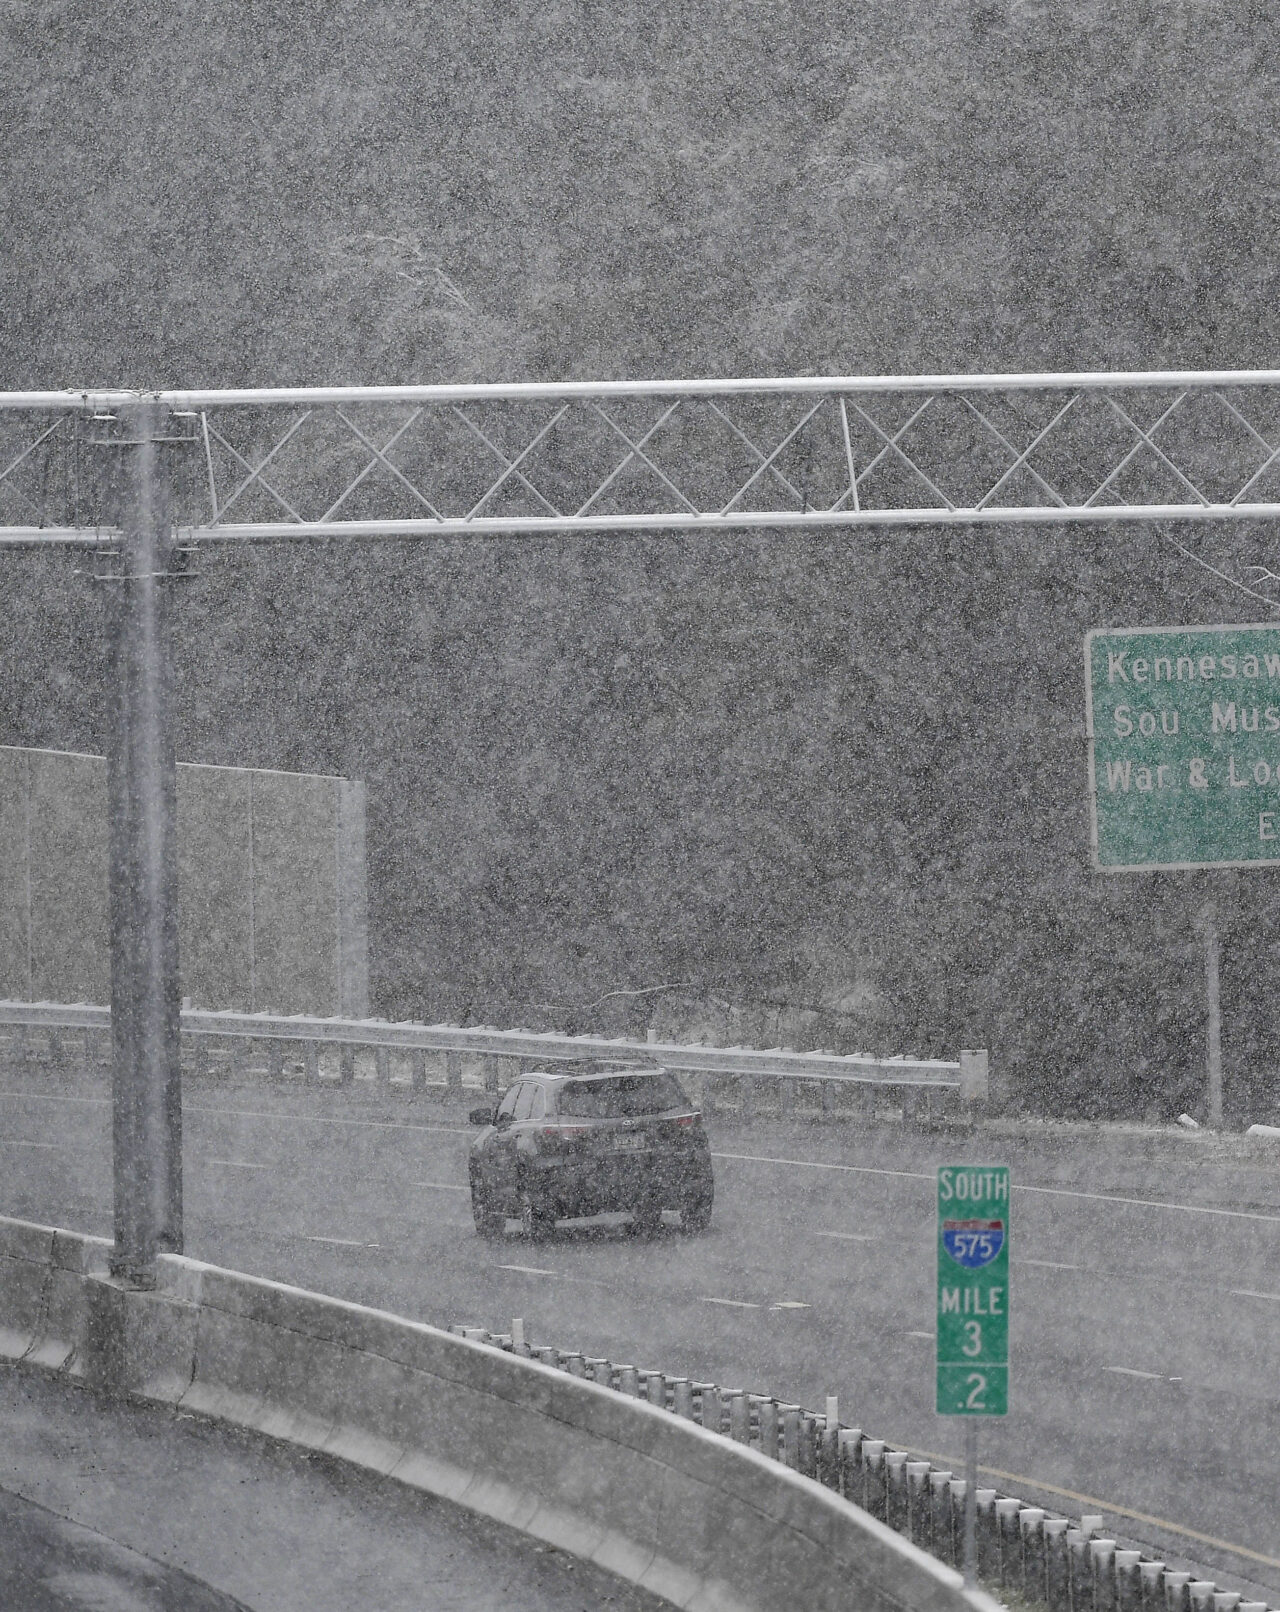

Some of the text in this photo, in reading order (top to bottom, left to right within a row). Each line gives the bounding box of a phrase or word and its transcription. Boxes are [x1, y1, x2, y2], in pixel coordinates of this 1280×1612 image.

[1113, 705, 1179, 738] Sou
[1106, 761, 1167, 793] War
[1188, 757, 1209, 789] &
[940, 1169, 1009, 1201] SOUTH
[953, 1233, 993, 1259] 575
[941, 1286, 1003, 1316] MILE
[962, 1320, 983, 1357] 3
